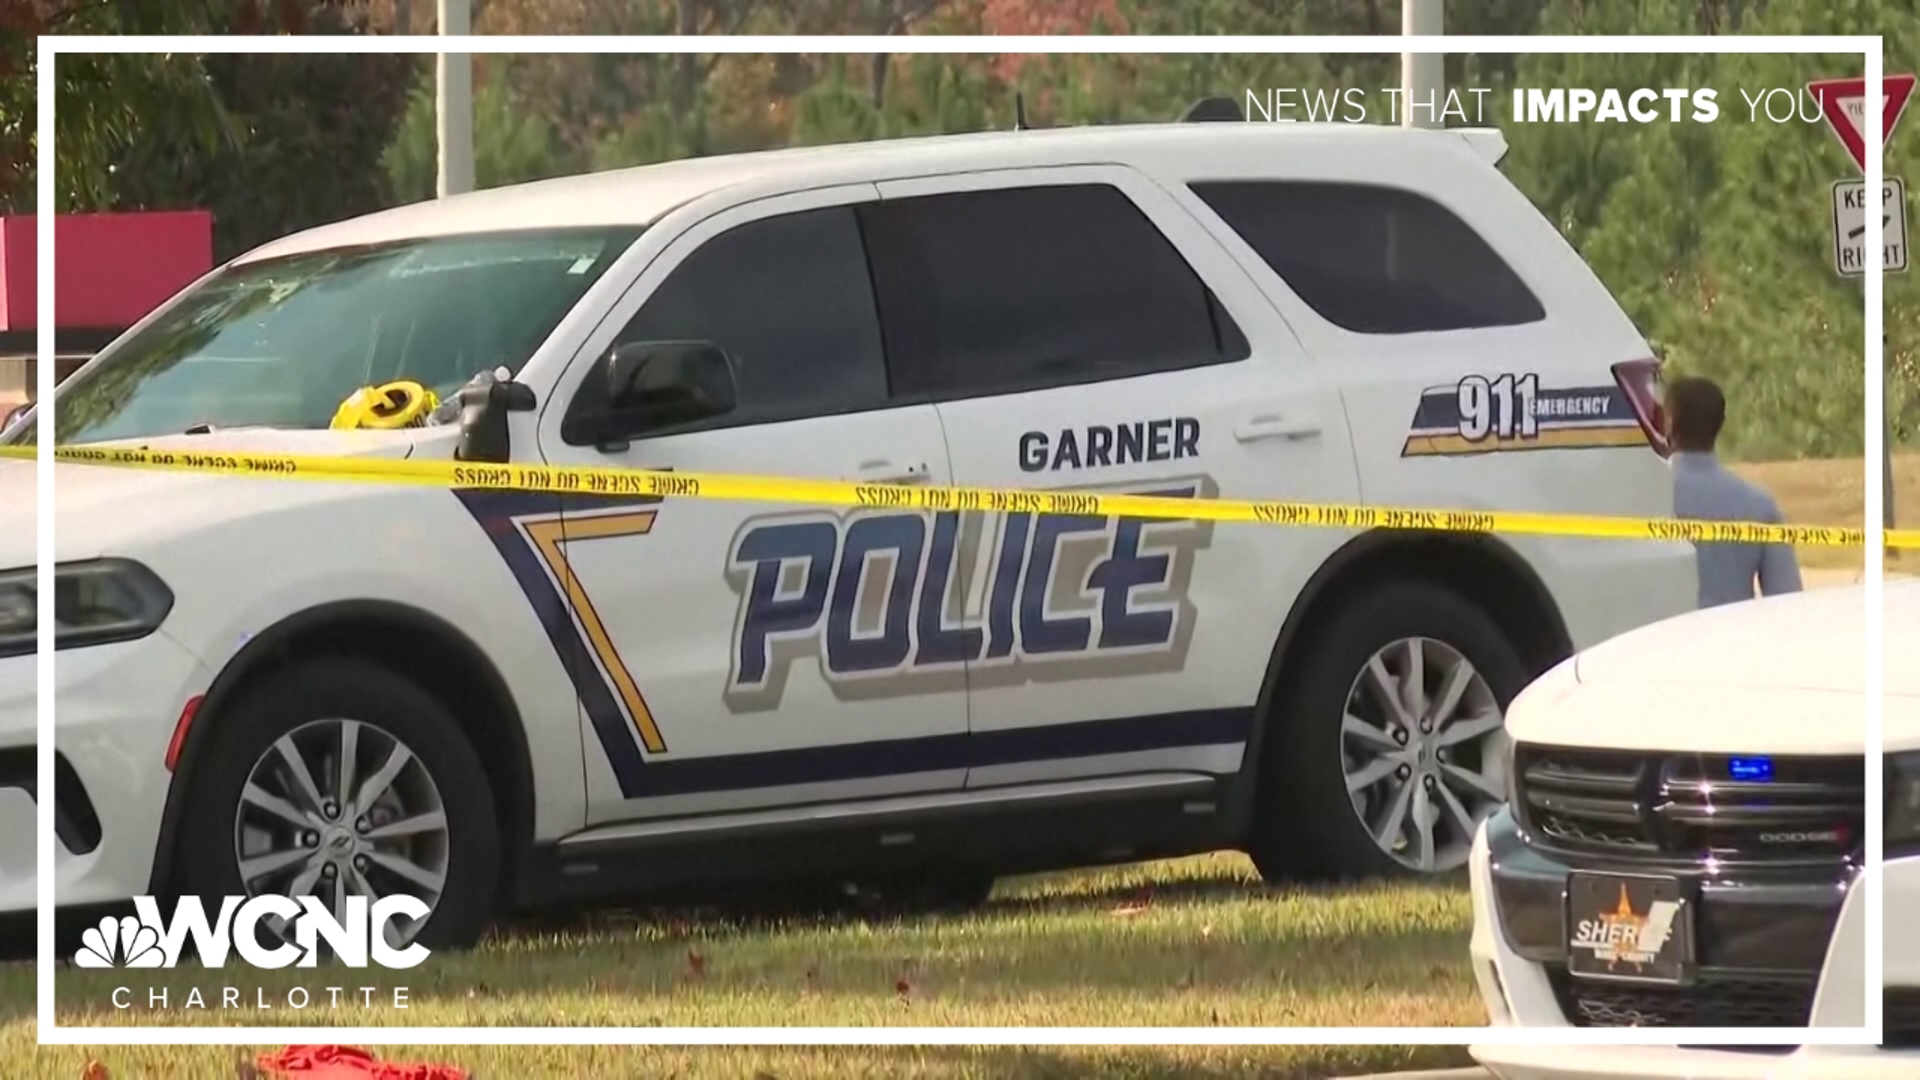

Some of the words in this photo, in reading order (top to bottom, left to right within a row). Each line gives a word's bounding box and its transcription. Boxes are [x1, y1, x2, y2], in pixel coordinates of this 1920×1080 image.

[1844, 187, 1893, 209] KEP
[1843, 244, 1900, 267] RIHT
[1456, 374, 1539, 442] 911
[1528, 396, 1611, 416] EMERGENCY
[1018, 416, 1201, 472] GARNER
[247, 459, 297, 473] CRIME
[454, 467, 511, 486] CROSS
[519, 469, 550, 488] NOT
[557, 471, 580, 488] DO
[588, 473, 641, 494] SCENE
[649, 476, 700, 496] CRIME
[856, 486, 911, 506] CROSS
[921, 488, 950, 508] NOT
[958, 489, 980, 508] DO
[989, 491, 1041, 512] SCENE
[1050, 494, 1099, 513] CRIME
[1253, 504, 1309, 524] CROSS
[1318, 506, 1347, 526] NOT
[1355, 507, 1375, 527] DO
[1384, 509, 1436, 529] SCENE
[1443, 512, 1494, 531] CRIME
[1648, 521, 1703, 543] CROSS
[1712, 523, 1740, 542] NOT
[1779, 527, 1830, 546] SCENE
[727, 478, 1208, 704] POLICE
[1576, 919, 1673, 946] SHER
